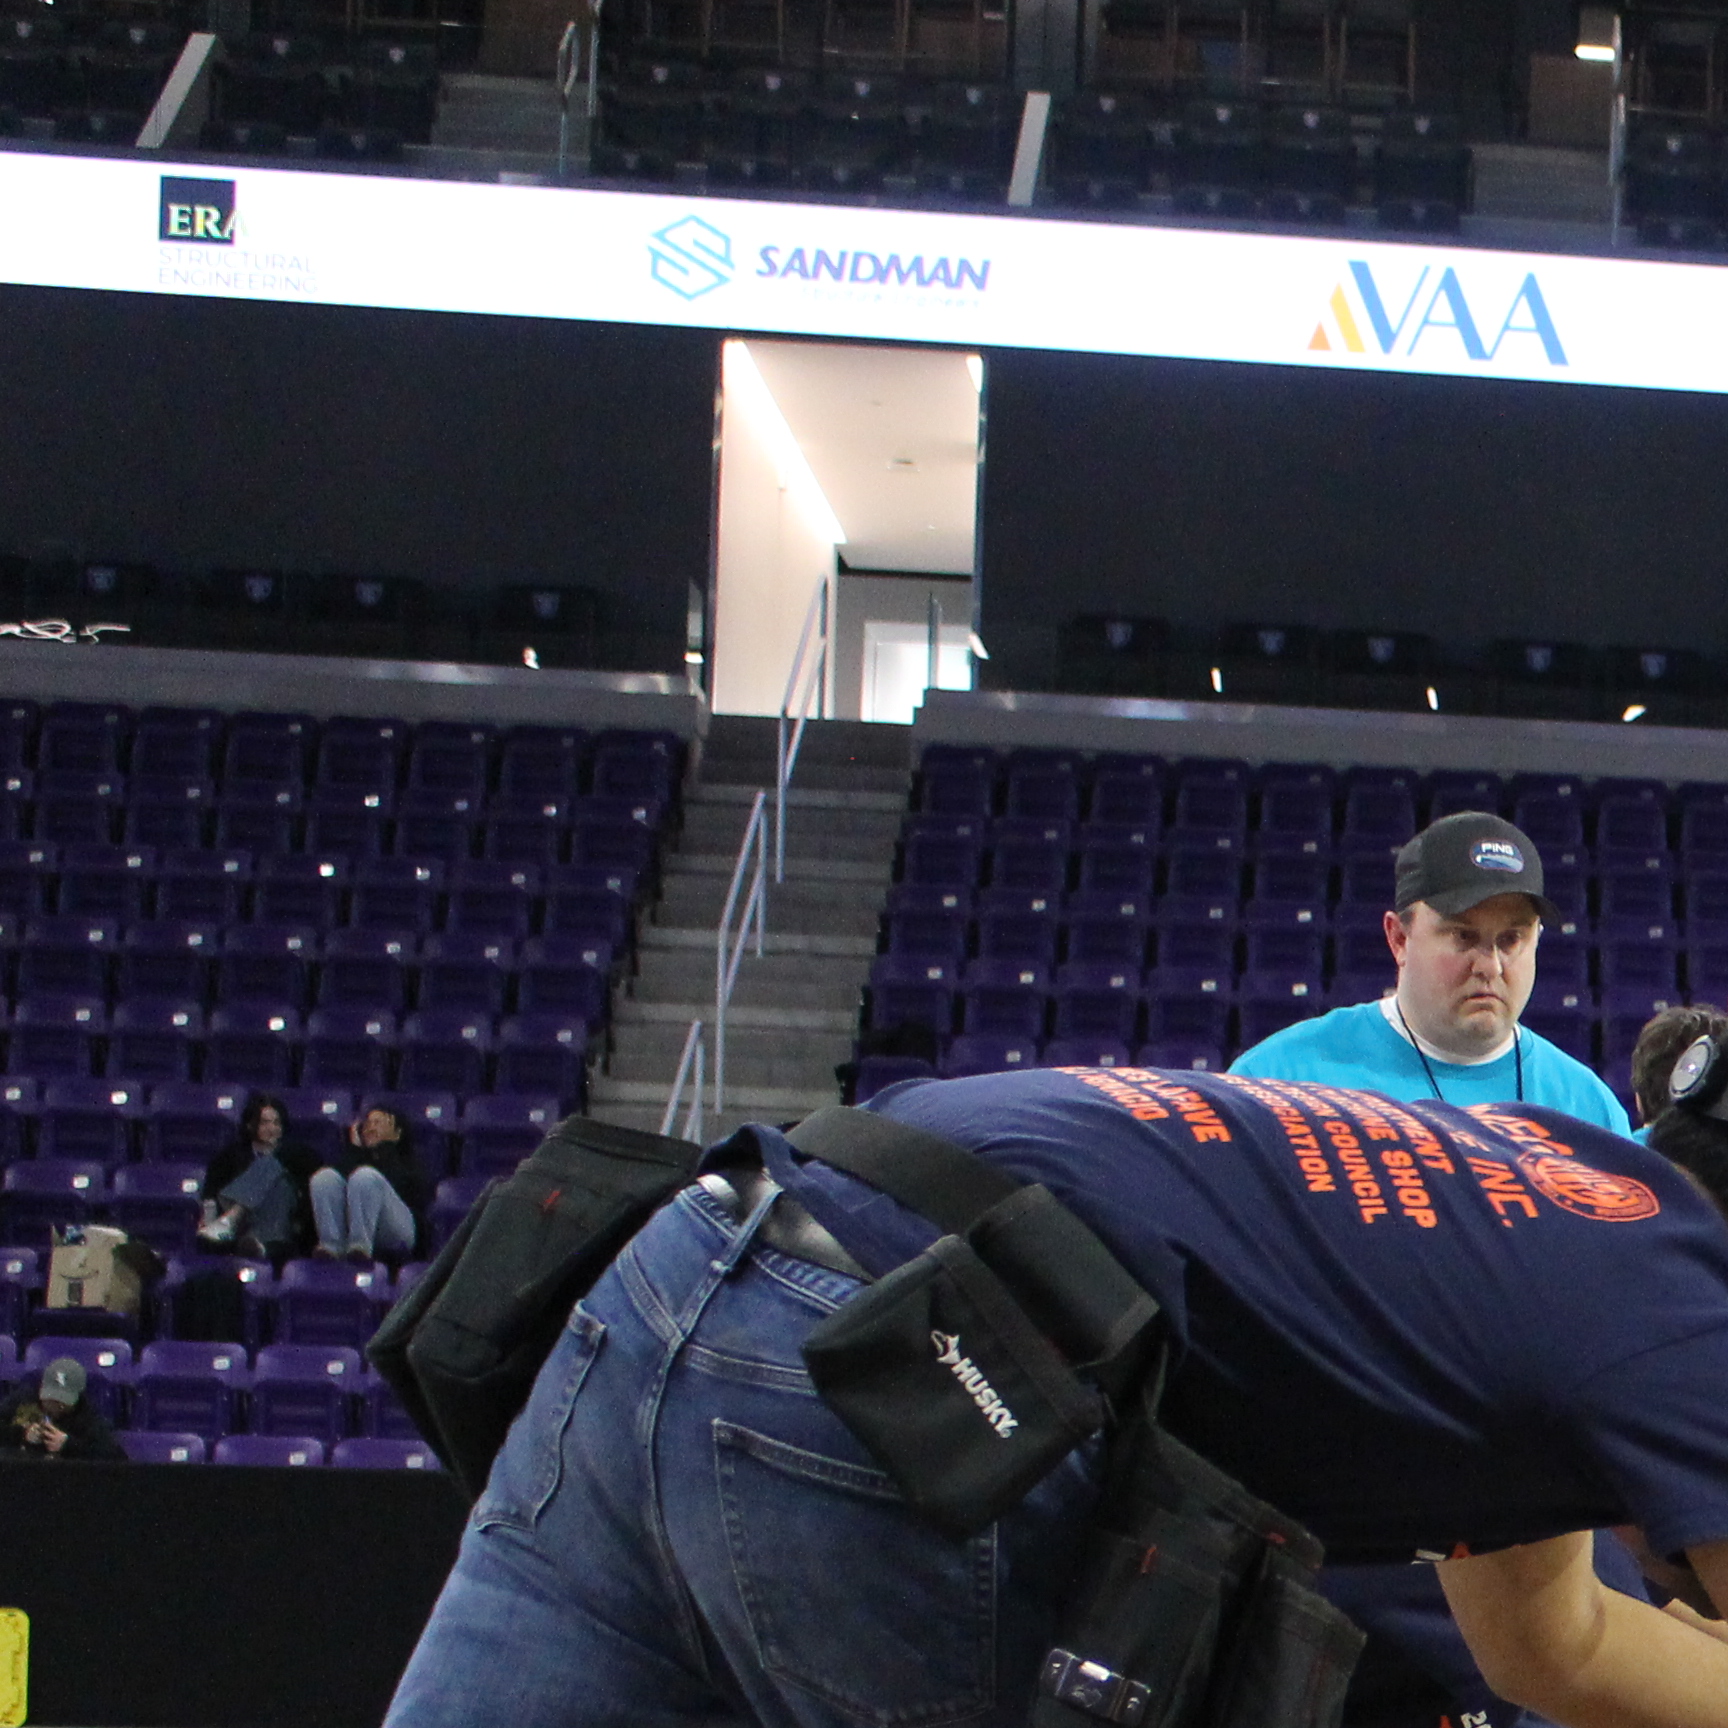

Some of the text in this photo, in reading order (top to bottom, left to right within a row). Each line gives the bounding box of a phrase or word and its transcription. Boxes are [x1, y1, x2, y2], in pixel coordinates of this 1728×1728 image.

[158, 267, 319, 295] ENGINEERING
[159, 246, 316, 274] STRUCTURAL
[756, 245, 991, 292] SANDMAN
[1349, 260, 1569, 367] VAA
[1481, 842, 1514, 856] PING
[1323, 1121, 1389, 1224] COUNCIL
[1381, 1149, 1439, 1229] SHOP
[1467, 1156, 1539, 1228] INC.
[951, 1356, 1019, 1433] HUSKY
